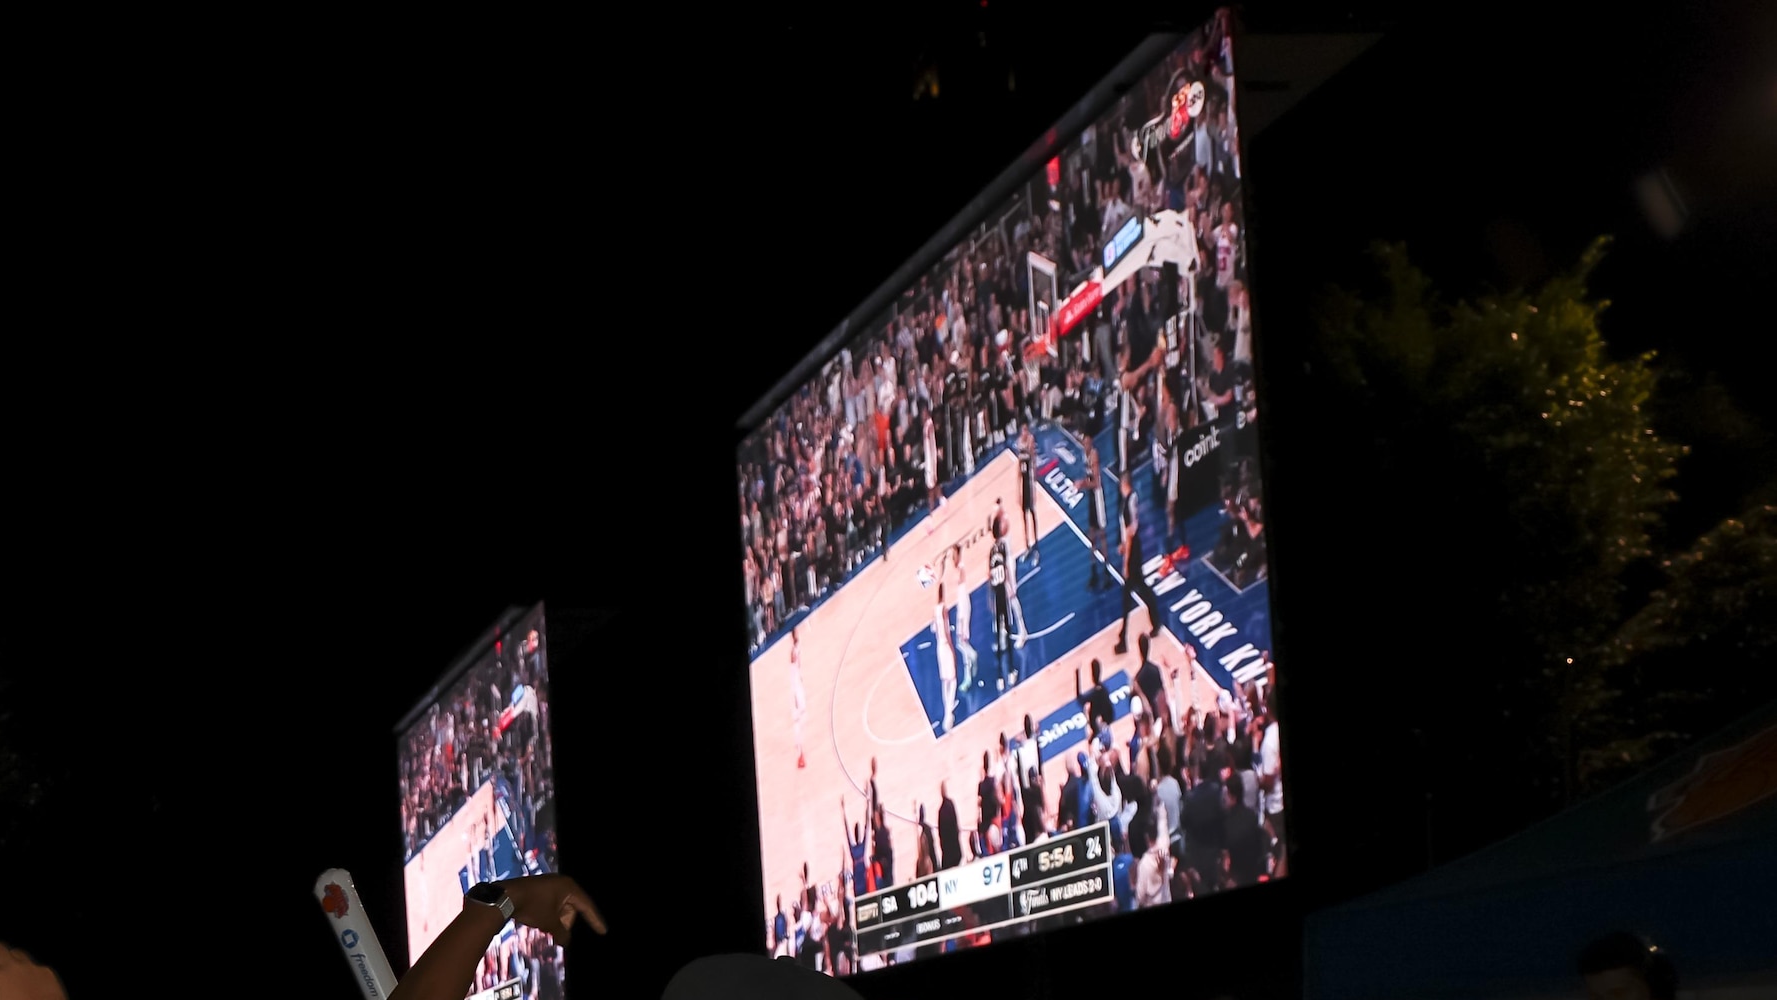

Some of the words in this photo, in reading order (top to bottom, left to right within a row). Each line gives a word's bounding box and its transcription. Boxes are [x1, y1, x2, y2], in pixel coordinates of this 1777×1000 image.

[1169, 588, 1238, 650] YORK
[1037, 844, 1075, 872] 5:54
[1085, 835, 1103, 860] 24
[944, 878, 960, 895] NY
[982, 862, 1004, 887] 97
[882, 895, 898, 915] SA
[907, 880, 939, 909] 104
[916, 918, 941, 935] BONUS
[350, 952, 380, 998] freedom
